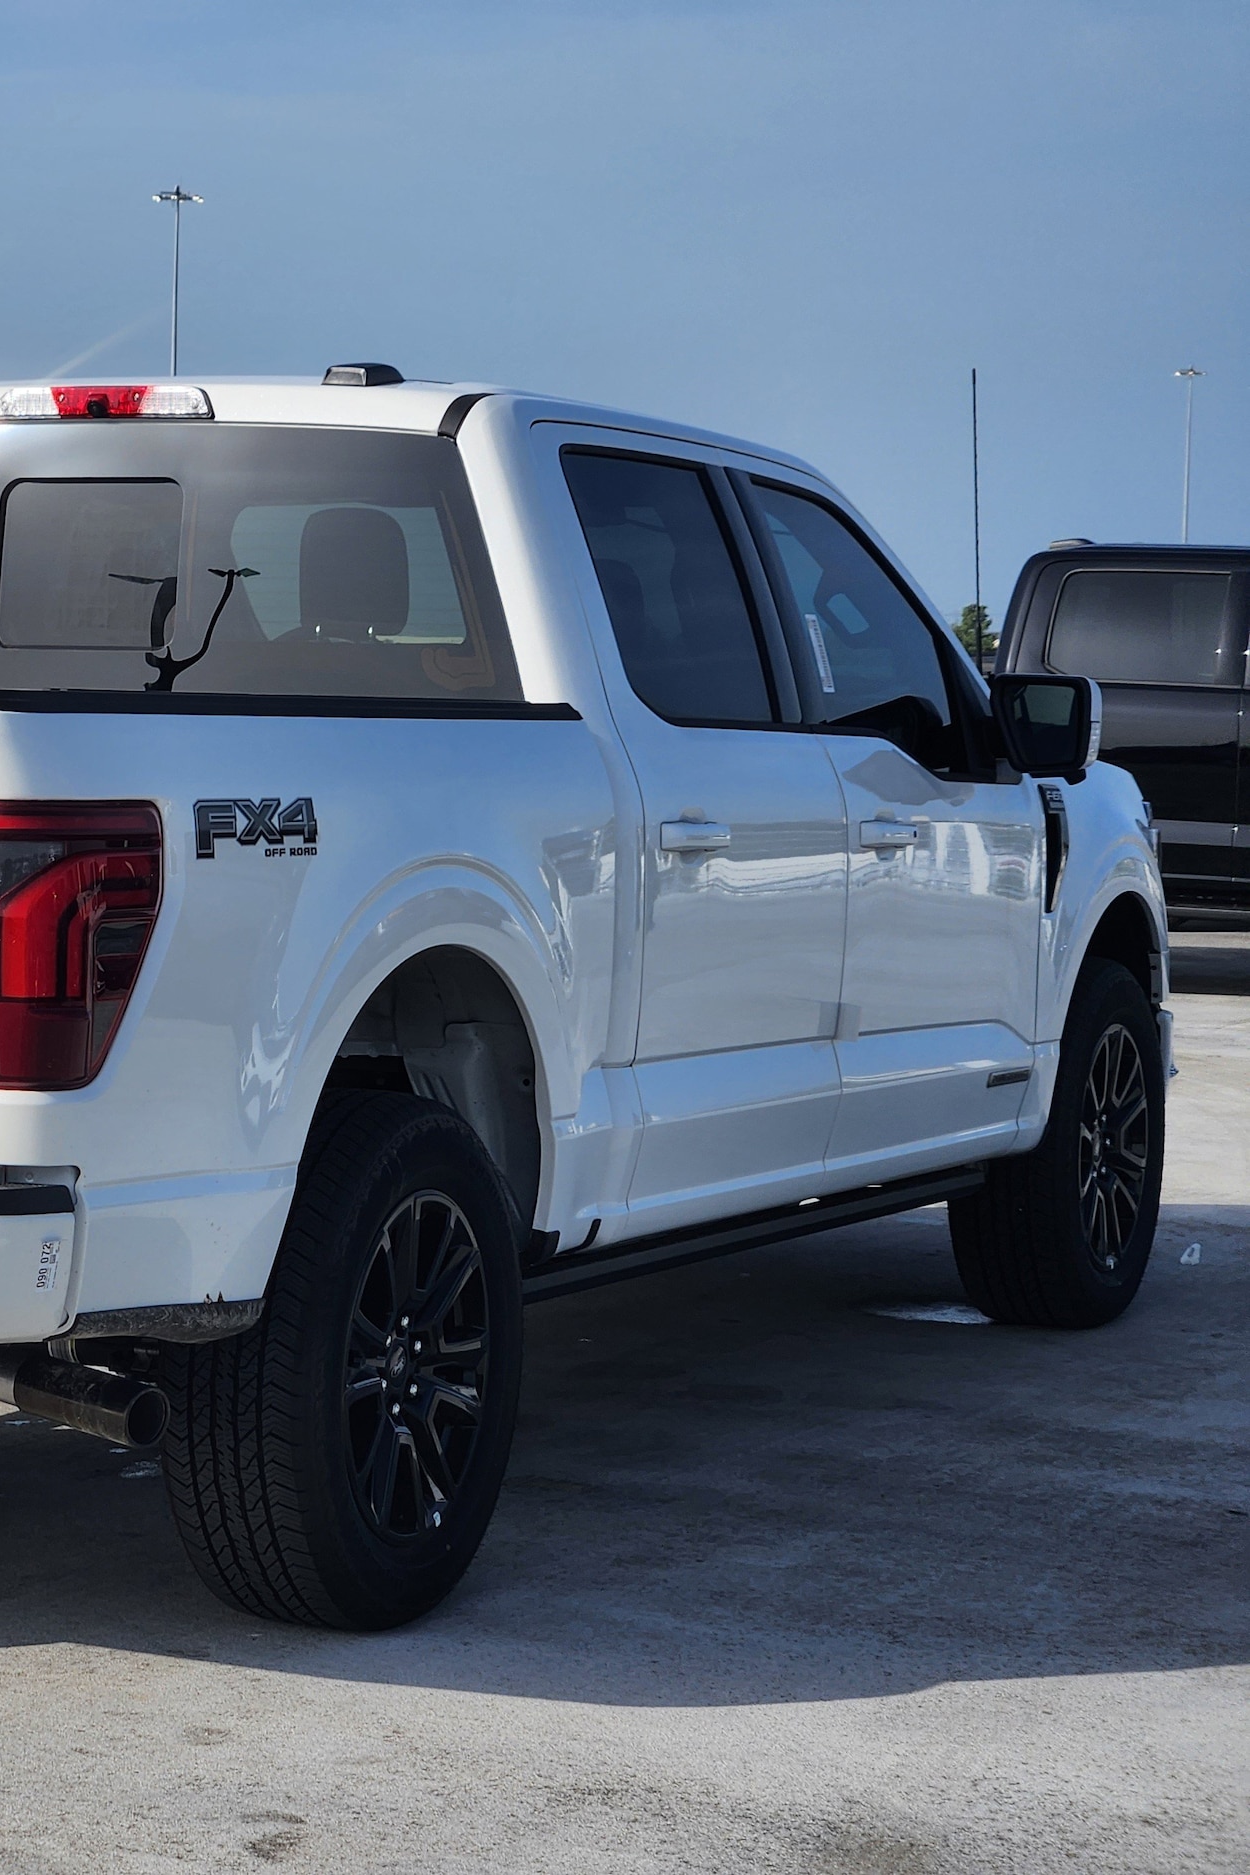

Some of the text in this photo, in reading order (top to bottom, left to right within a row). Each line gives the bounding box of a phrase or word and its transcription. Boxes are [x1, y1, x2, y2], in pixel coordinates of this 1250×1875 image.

[193, 797, 318, 860] FX4
[264, 846, 318, 858] OFF ROAD
[36, 1243, 52, 1288] 090 072
